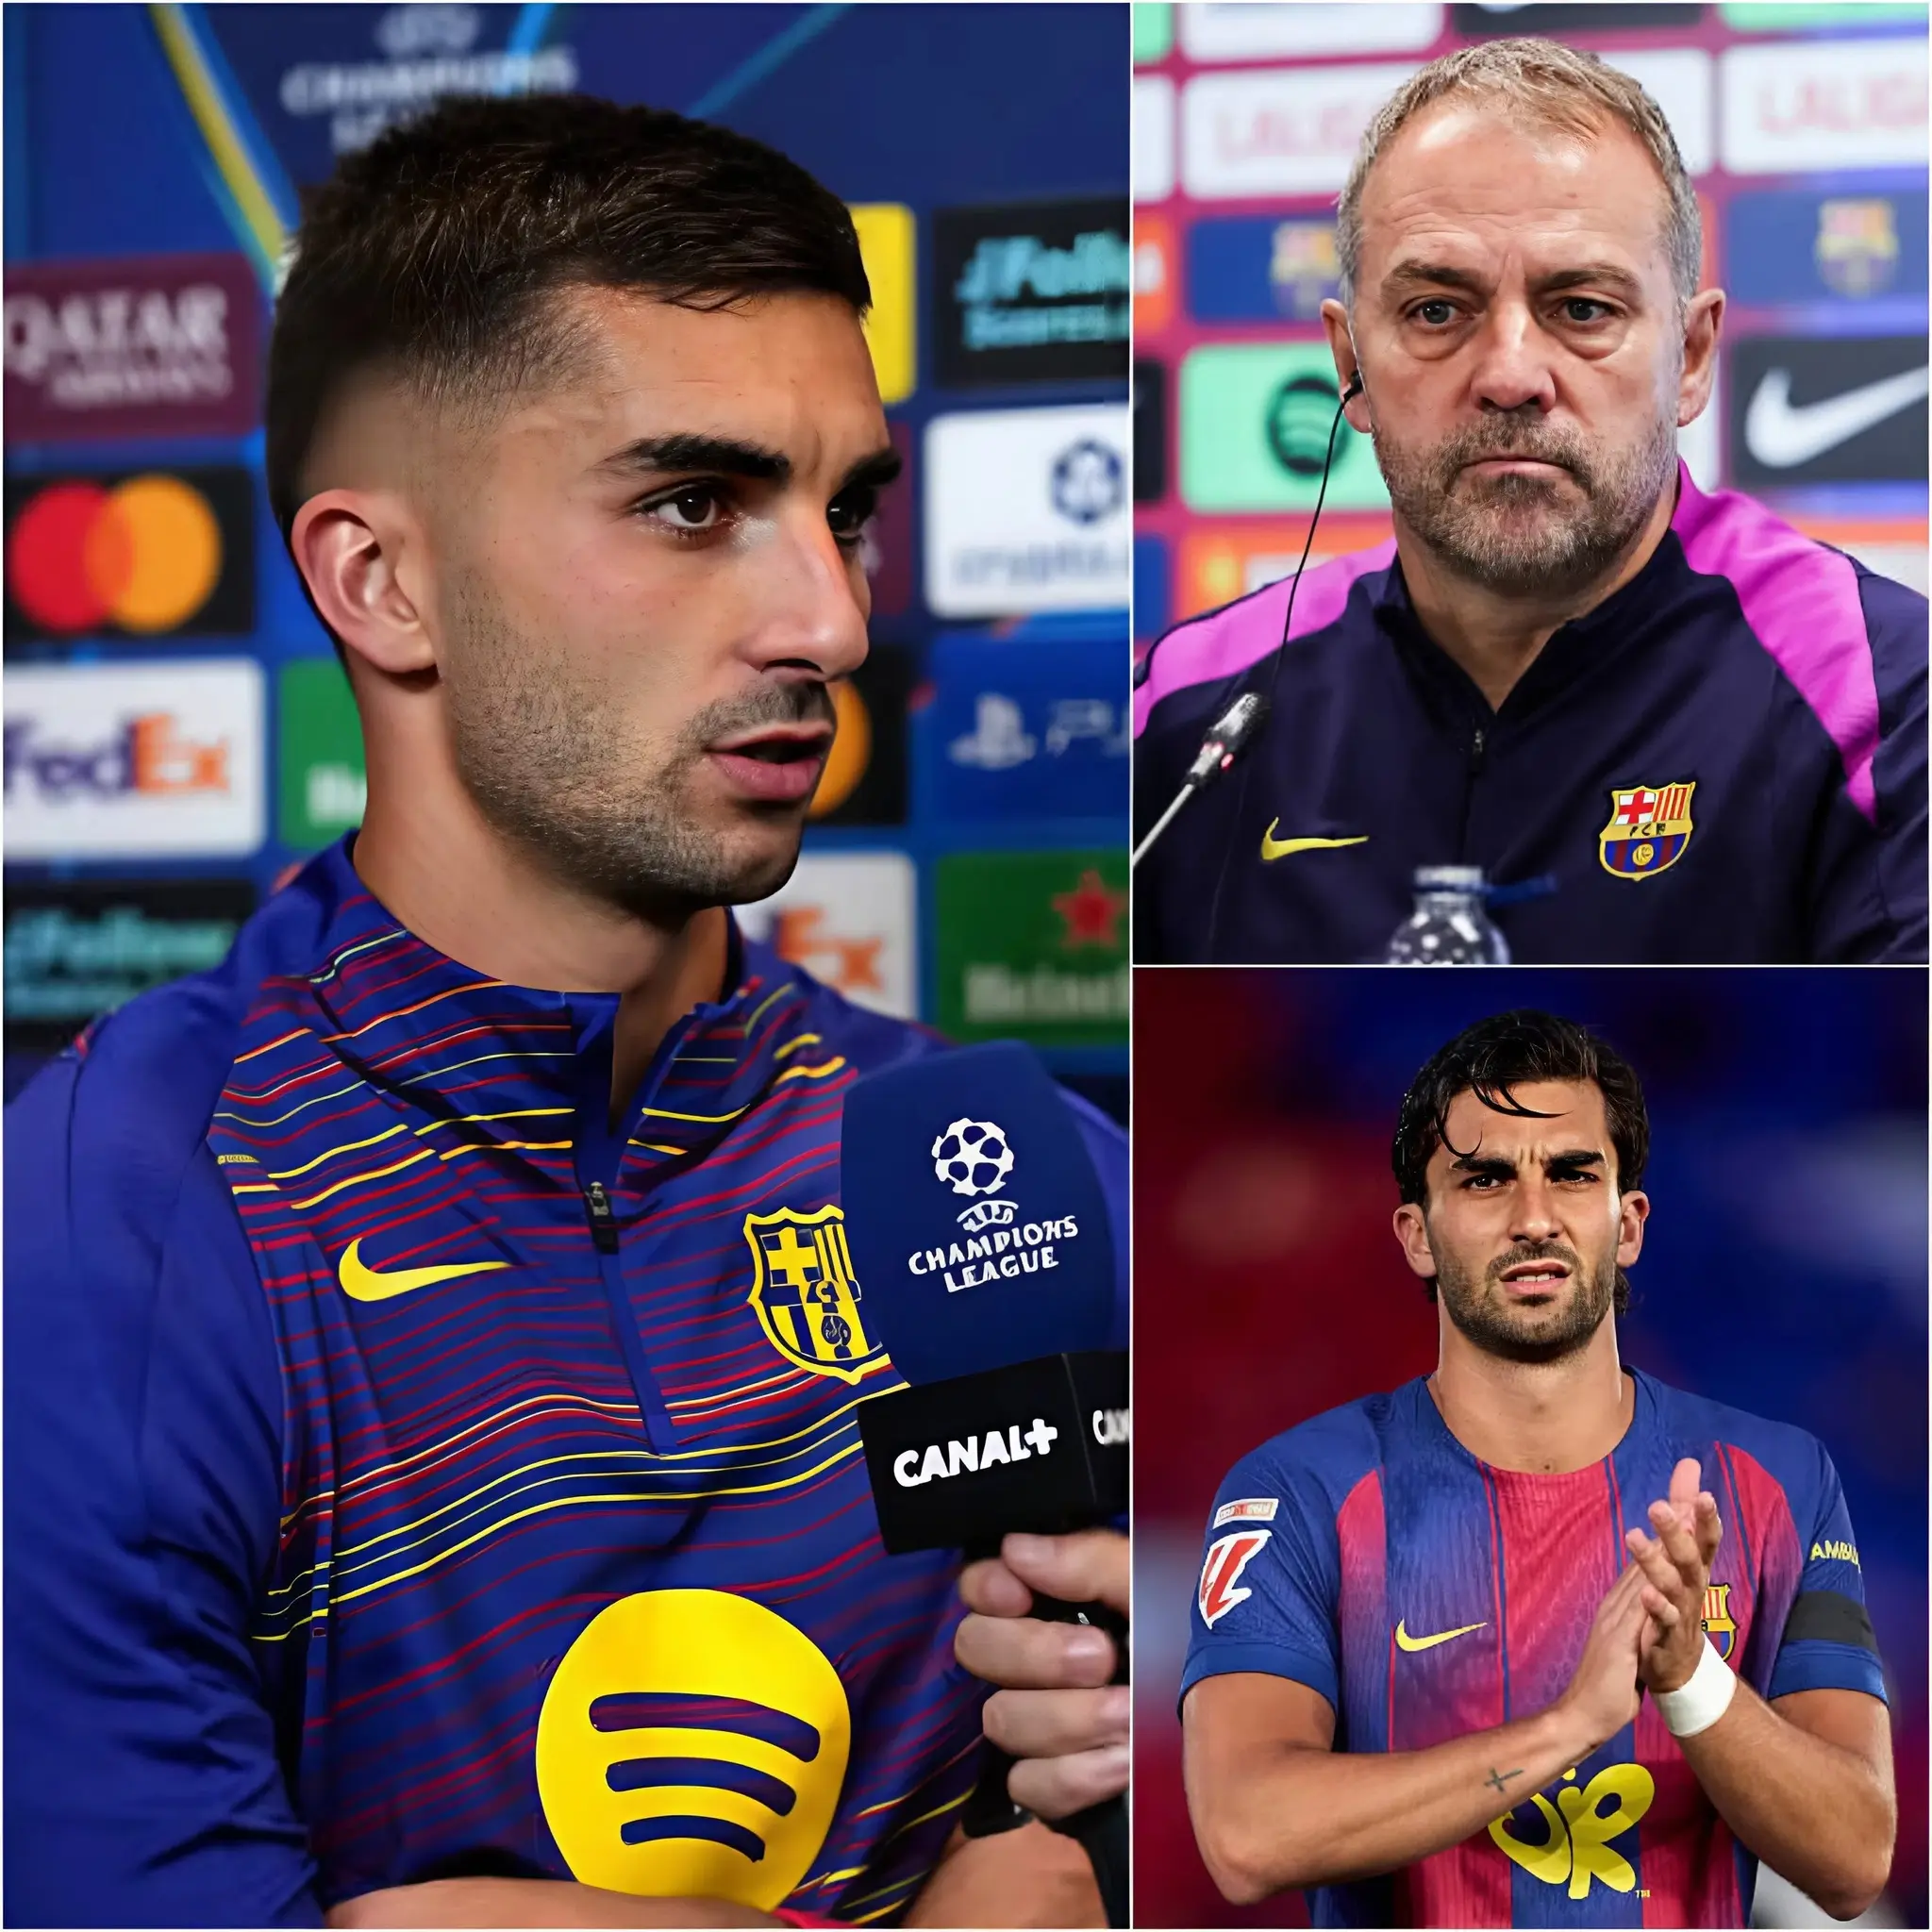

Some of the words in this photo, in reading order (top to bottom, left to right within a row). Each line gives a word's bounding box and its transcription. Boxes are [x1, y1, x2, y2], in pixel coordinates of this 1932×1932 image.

[908, 1215, 1079, 1276] CHAMPIONS
[943, 1245, 1059, 1293] LEAGUE
[892, 1418, 1058, 1489] CANAL+
